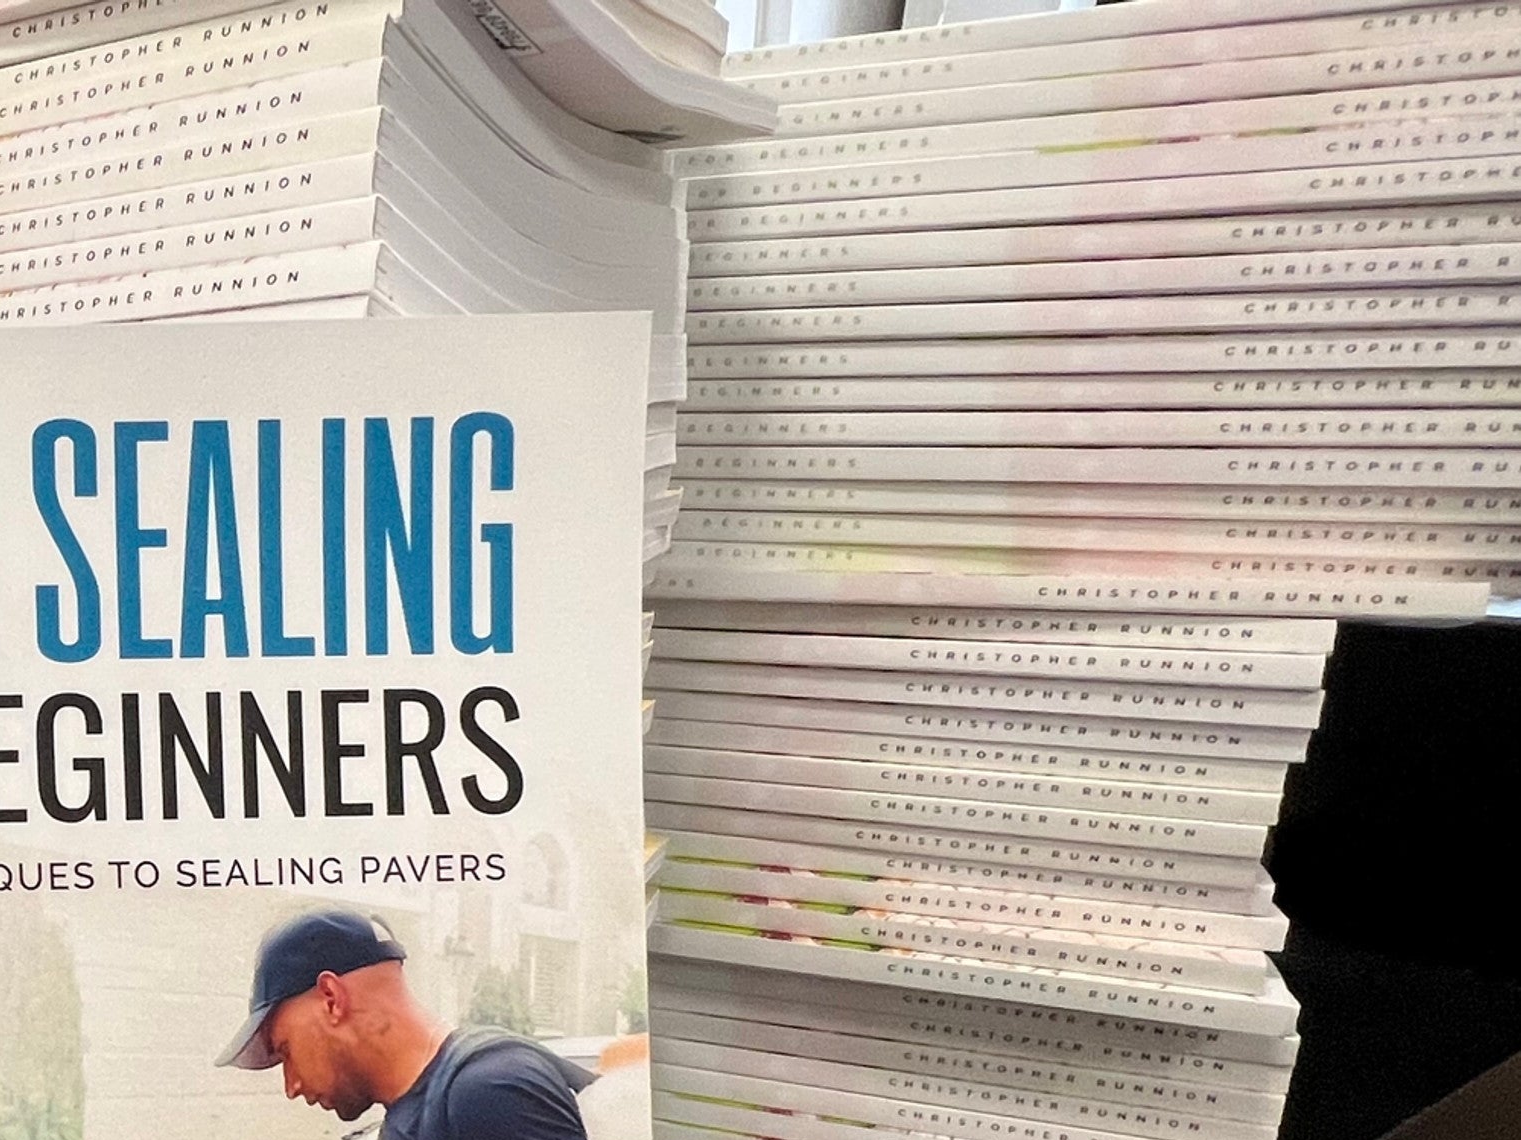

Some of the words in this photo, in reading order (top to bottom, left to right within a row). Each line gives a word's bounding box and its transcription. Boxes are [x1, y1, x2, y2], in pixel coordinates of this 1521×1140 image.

[12, 0, 179, 38] CHRISTOPH
[1361, 6, 1509, 30] CHRISTO
[14, 36, 182, 84] CHRISTOPHER
[203, 2, 329, 42] RUNNION
[1327, 50, 1520, 75] CHRISTOPH
[0, 72, 165, 119] CHRISTOPHER
[185, 40, 311, 77] RUNNION
[179, 91, 303, 128] RUNNION
[1332, 91, 1521, 114] CHRISTOPH
[183, 128, 310, 162] RUNNION
[1326, 130, 1520, 152] CHRISTOPH
[186, 172, 313, 205] RUNNION
[1309, 166, 1521, 189] CHRISTOPHE
[186, 217, 314, 248] RUNNION
[1232, 218, 1459, 238] CHRISTOPHER
[1241, 257, 1469, 277] CHRISTOPHER
[173, 271, 299, 298] RUNNION
[1244, 297, 1469, 313] CHRISTOPHER
[1225, 341, 1446, 356] CHRISTOPHER
[700, 386, 840, 397] EGINNERS
[1213, 380, 1433, 392] CHRISTOPHER
[1219, 422, 1439, 433] CHRISTOPHER
[1228, 460, 1444, 472] CHRISTOPHER
[1222, 495, 1436, 508] CHRISTOPHER
[31, 411, 515, 663] SEALING
[1226, 528, 1437, 542] CHRISTOPHER
[1211, 561, 1417, 575] CHRISTOPHER
[1441, 566, 1521, 578] RUNN
[1038, 586, 1239, 601] CHRISTOPHER
[1263, 591, 1409, 605] RUNNION
[911, 615, 1097, 632] CHRISTOPHER
[1120, 624, 1254, 639] RUNNION
[910, 650, 1096, 666] CHRISTOPHER
[1120, 658, 1254, 673] RUNNION
[905, 683, 1089, 701] CHRISTOPHER
[1112, 694, 1245, 710] RUNNION
[905, 716, 1087, 735] CHRISTOPHER
[1110, 729, 1242, 746] RUNNION
[879, 743, 1058, 766] CHRISTOPHER
[1080, 758, 1208, 776] RUNNION
[881, 771, 1060, 793] CHRISTOPHER
[1082, 787, 1210, 805] RUNNION
[870, 800, 1048, 823] CHRISTOPHER
[1070, 817, 1197, 837] RUNNION
[855, 831, 1030, 856] CHRISTOPHER
[1051, 850, 1176, 870] RUNNION
[108, 860, 160, 890] TO
[176, 857, 344, 888] SEALING
[361, 854, 507, 884] PAVERS
[886, 859, 1063, 884] CHRISTOPHER
[1085, 878, 1210, 898] RUNNION
[885, 894, 1061, 918] CHRISTOPHER
[1082, 913, 1208, 933] RUNNION
[861, 927, 1037, 956] CHRISTOPHER
[1058, 951, 1183, 976] RUNNION
[887, 963, 1067, 994] CHRISTOPHER
[1089, 990, 1215, 1014] RUNNION
[902, 995, 1076, 1024] CHRISTOPHER
[1096, 1020, 1219, 1042] RUNNION
[910, 1021, 1083, 1051] CHRISTOPHER
[1103, 1047, 1224, 1071] RUNNION
[904, 1052, 1076, 1083] CHRISTOPHER
[1096, 1079, 1218, 1104] RUNNION
[888, 1078, 1058, 1110] CHRISTOPHER
[1080, 1106, 1200, 1131] RUNNION
